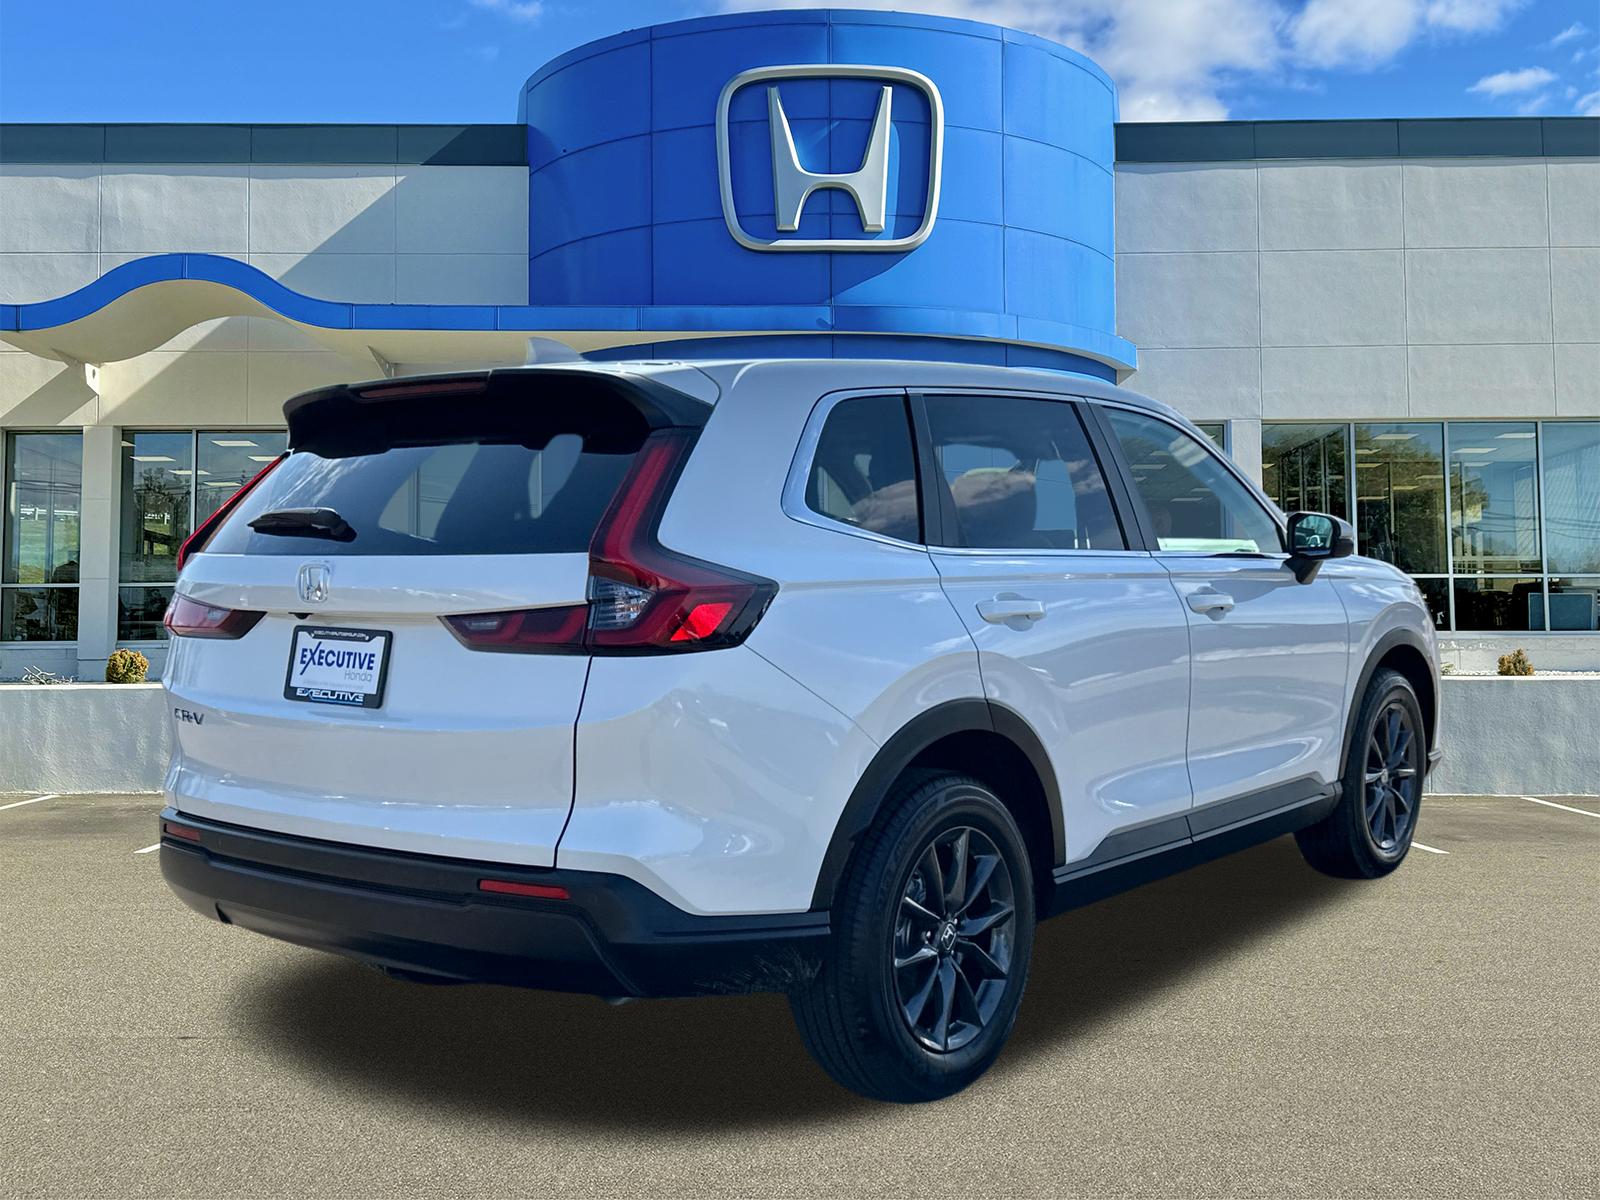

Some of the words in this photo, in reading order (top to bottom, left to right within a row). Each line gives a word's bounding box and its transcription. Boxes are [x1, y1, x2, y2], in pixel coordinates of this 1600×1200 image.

[299, 641, 376, 675] EXECUTIVE
[344, 670, 373, 682] Honda
[296, 688, 365, 703] EXECUTIVE
